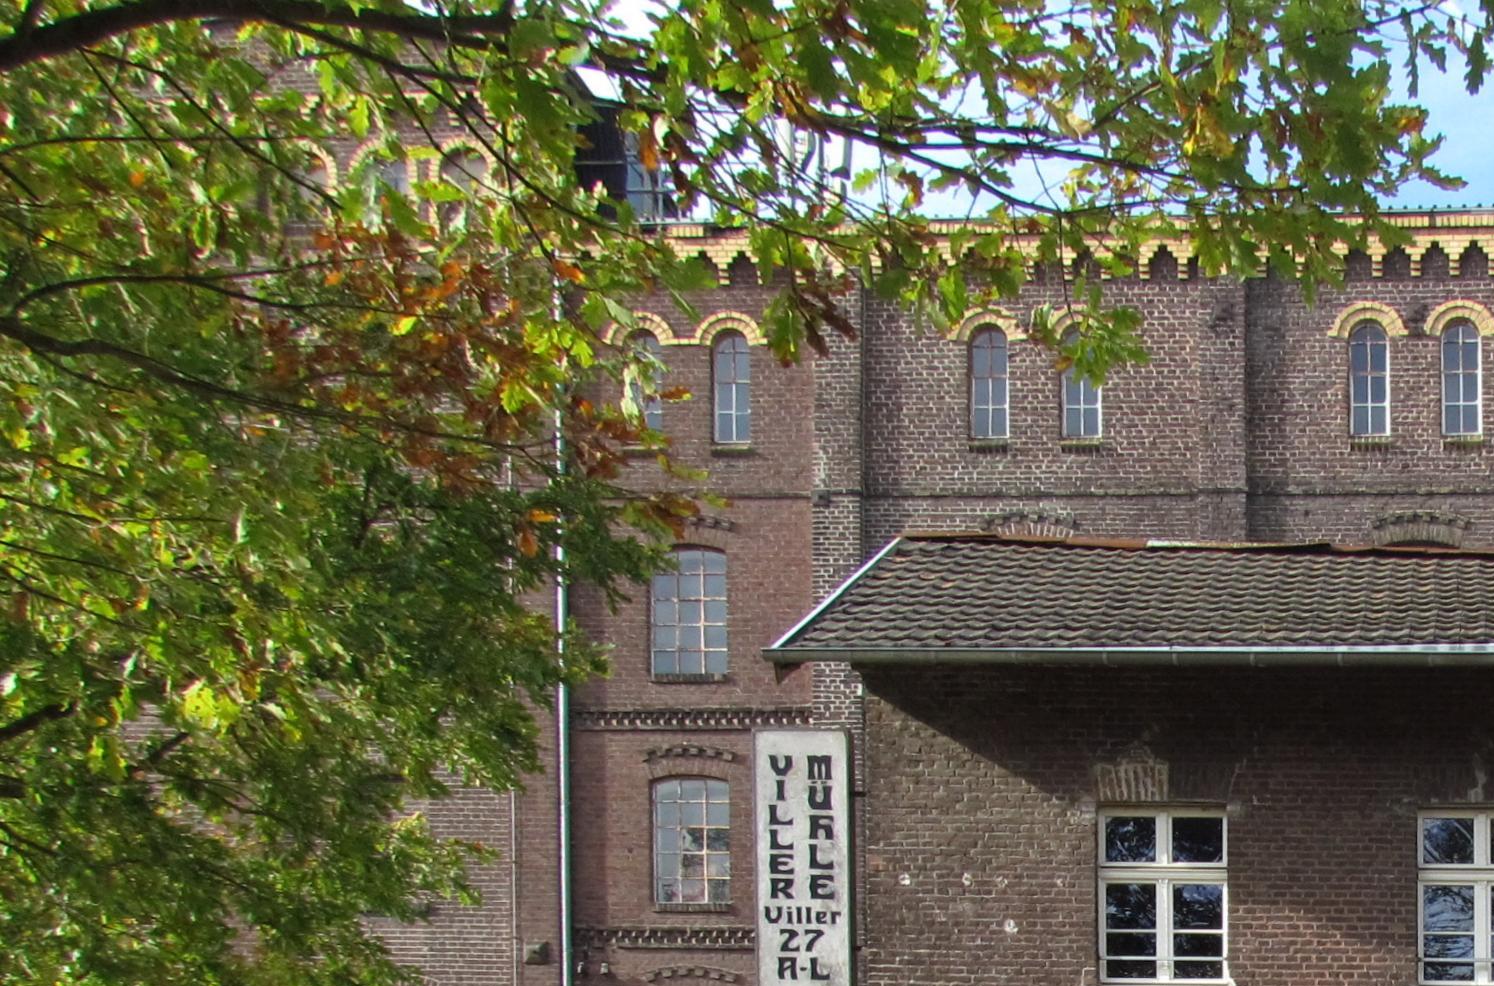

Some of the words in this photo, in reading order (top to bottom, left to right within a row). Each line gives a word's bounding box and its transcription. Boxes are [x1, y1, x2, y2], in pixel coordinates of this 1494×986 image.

[768, 754, 794, 899] VILLER
[807, 754, 834, 899] MÜHLE
[764, 906, 841, 925] Viller
[778, 928, 825, 952] 27
[777, 956, 830, 980] A-L
